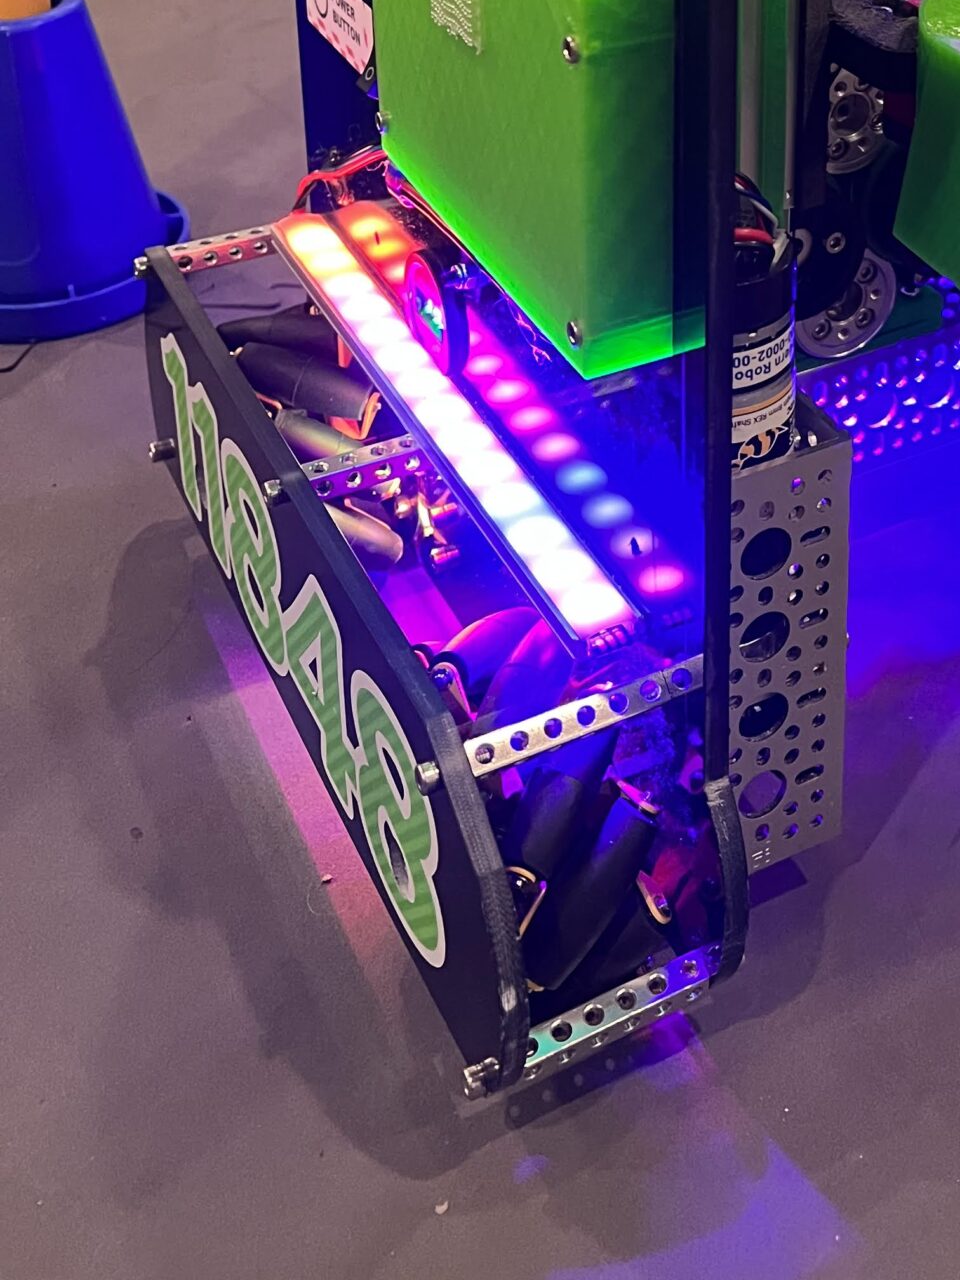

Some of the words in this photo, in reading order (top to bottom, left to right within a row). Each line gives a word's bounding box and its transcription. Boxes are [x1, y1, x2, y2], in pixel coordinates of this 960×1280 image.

[333, 9, 361, 46] BUTTON
[734, 361, 771, 381] Robo
[733, 417, 751, 429] Shaf
[160, 333, 446, 968] 11848
